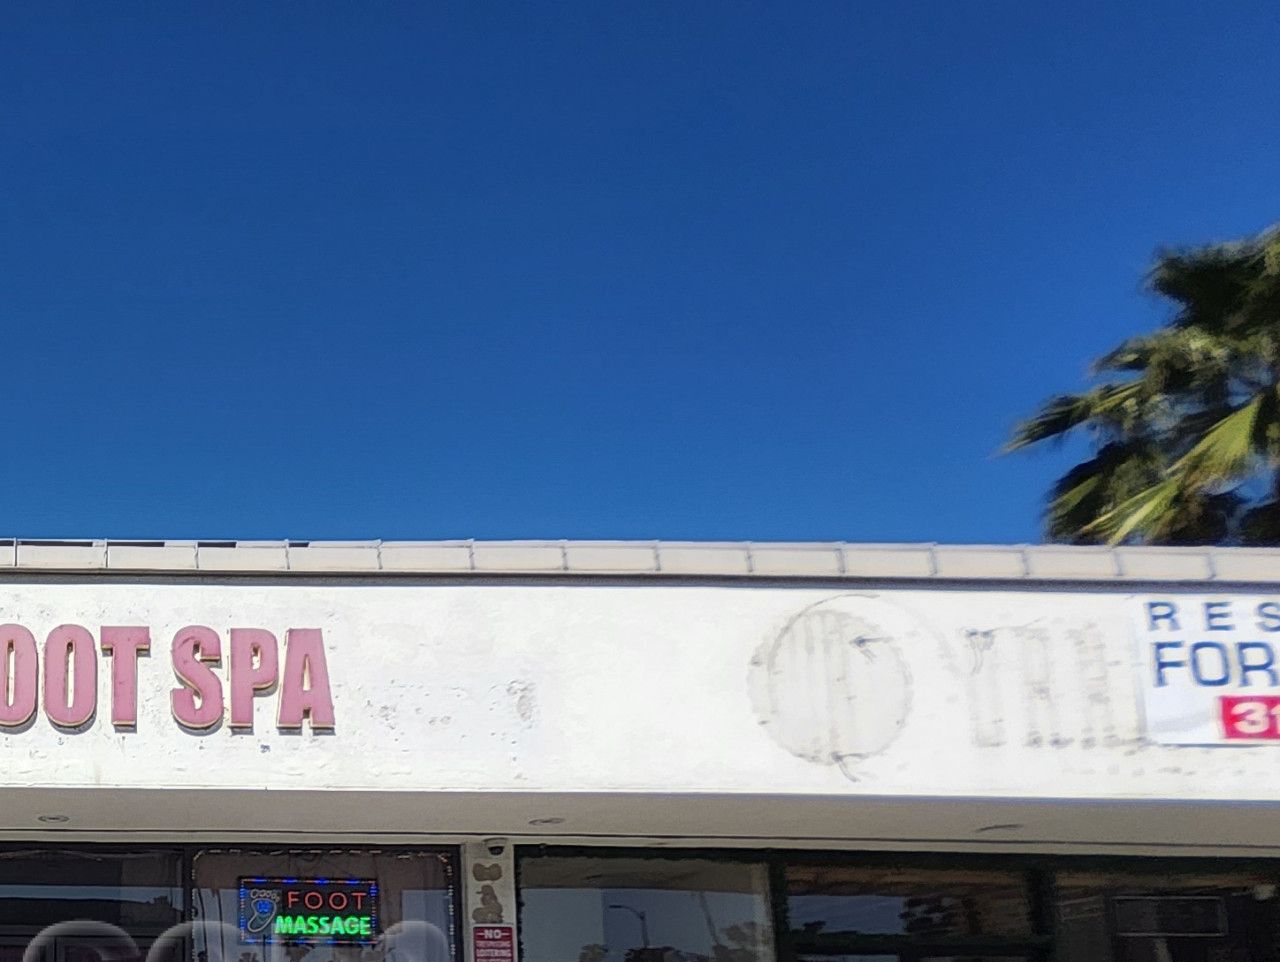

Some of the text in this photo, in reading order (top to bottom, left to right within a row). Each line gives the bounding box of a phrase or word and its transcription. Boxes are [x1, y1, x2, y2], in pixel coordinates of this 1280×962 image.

[1151, 640, 1280, 687] FOR
[170, 625, 335, 731] SPA
[287, 890, 367, 910] FOOT
[275, 916, 371, 935] MASSAGE
[484, 929, 502, 939] NO
